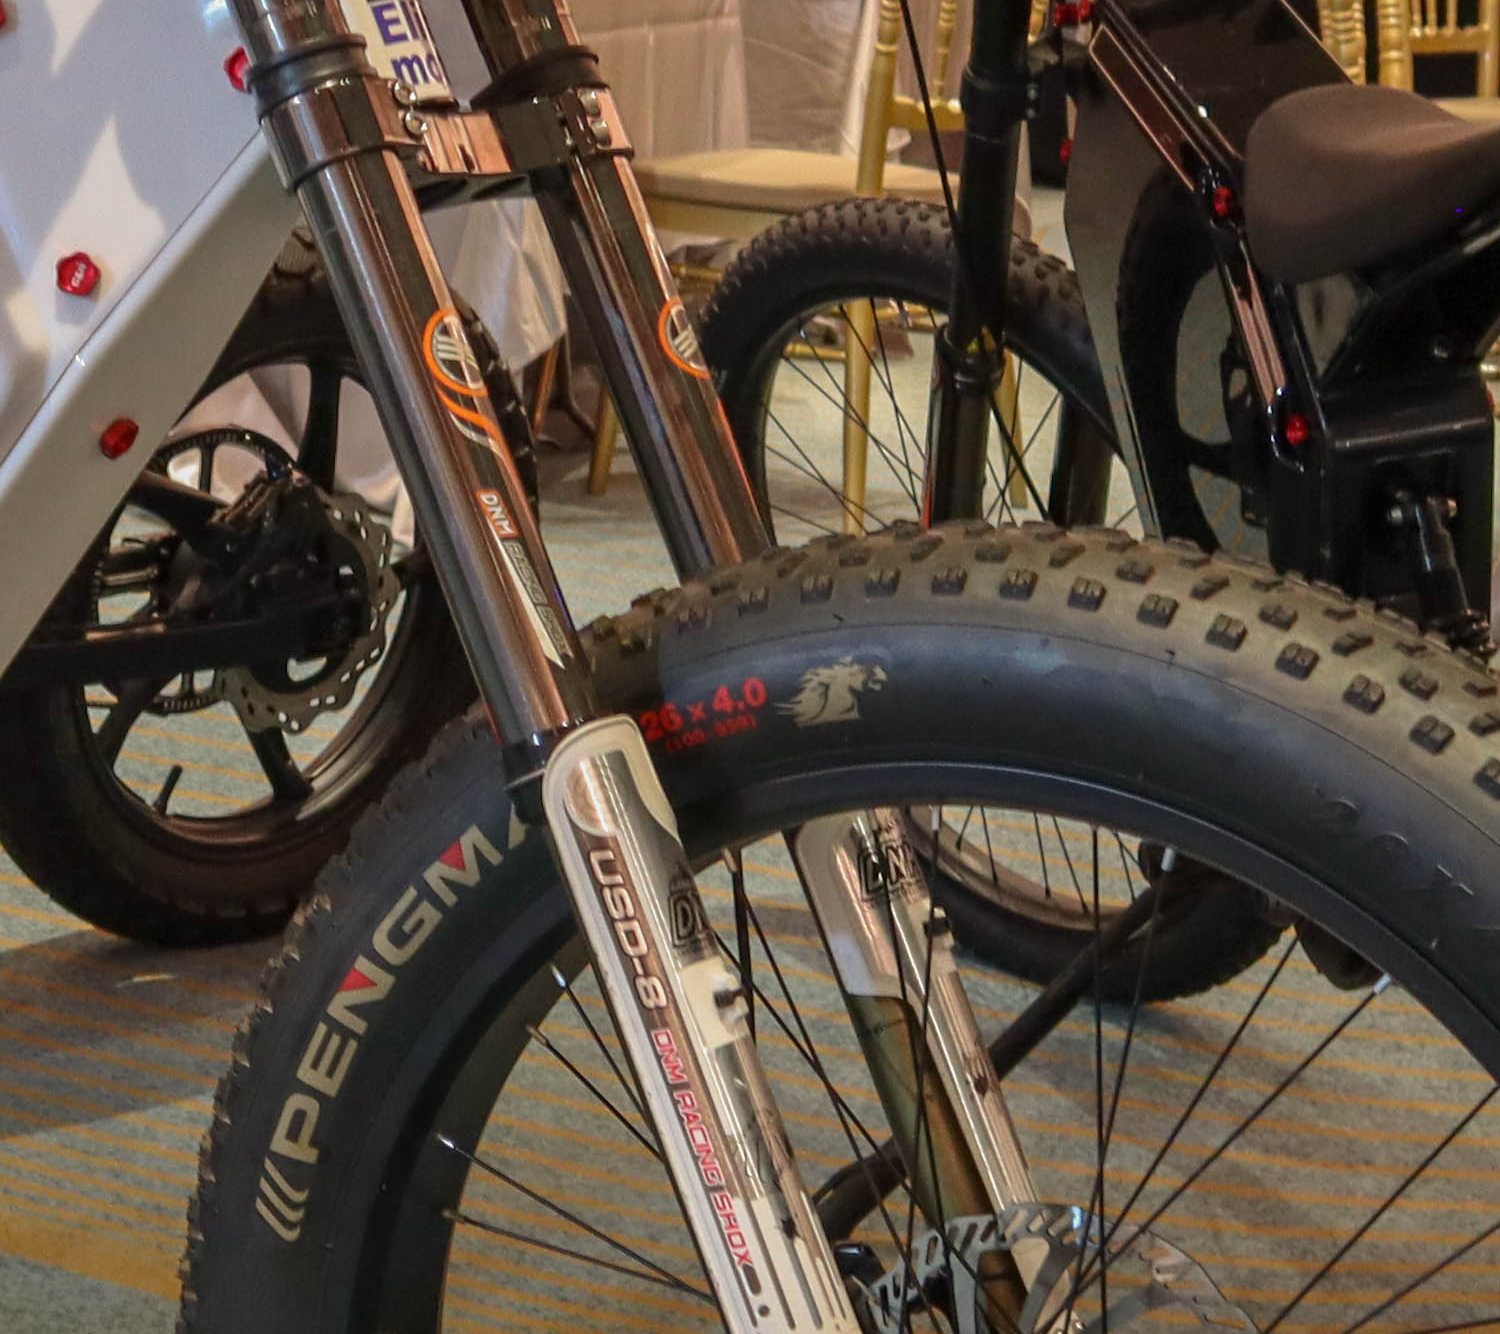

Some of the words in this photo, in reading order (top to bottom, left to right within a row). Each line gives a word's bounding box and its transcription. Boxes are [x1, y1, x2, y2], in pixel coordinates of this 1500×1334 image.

[479, 492, 518, 535] DNM
[639, 702, 683, 741] 26
[712, 677, 768, 713] 4.0
[589, 848, 668, 1010] USD-8
[651, 1028, 688, 1085] DNM
[674, 1089, 725, 1187] RACING
[710, 1191, 753, 1268] SHOX
